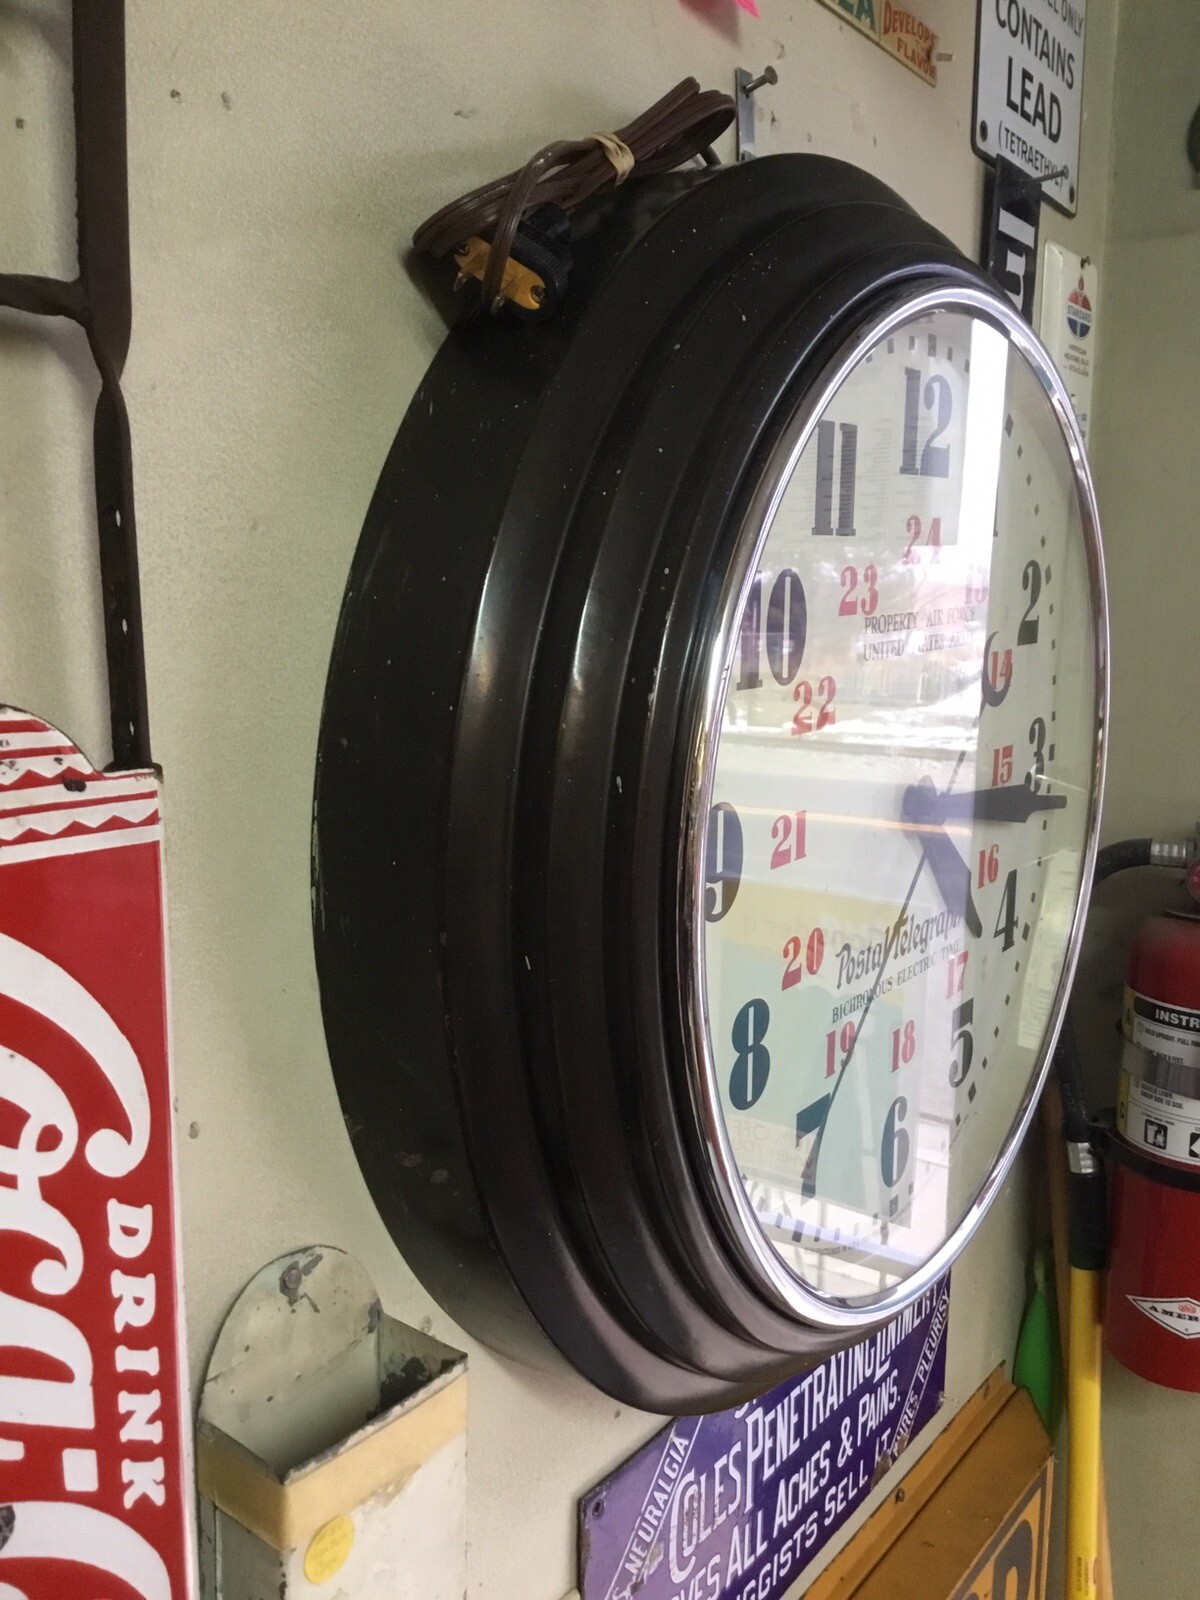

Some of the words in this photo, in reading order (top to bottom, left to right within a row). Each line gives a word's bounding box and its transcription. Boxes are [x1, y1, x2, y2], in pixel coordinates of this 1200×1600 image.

[996, 0, 1075, 90] CONTAINS
[1061, 0, 1084, 38] ONLY
[1006, 55, 1062, 144] LEAD
[1067, 304, 1092, 324] STANDARD
[900, 366, 952, 479] 12
[811, 419, 858, 537] 11
[902, 514, 942, 565] 24
[838, 563, 879, 617] 23
[864, 612, 919, 634] PROPERTY
[926, 608, 944, 628] AIR
[1016, 559, 1043, 647] 2
[736, 568, 808, 692] 10
[863, 638, 905, 662] UNITED
[990, 648, 1013, 690] 14
[790, 675, 837, 737] 22
[991, 744, 1014, 788] 15
[1024, 716, 1046, 796] 3
[705, 801, 744, 923] 9
[770, 809, 807, 871] 21
[977, 843, 1000, 890] 16
[993, 869, 1019, 953] 4
[781, 927, 825, 992] 20
[835, 927, 890, 991] Postal
[896, 952, 938, 987] ELECTRIC
[945, 950, 970, 1000] 17
[824, 1021, 856, 1080] 19
[890, 1019, 916, 1073] 18
[948, 997, 975, 1088] 5
[1155, 1008, 1200, 1030] INSTR
[729, 998, 771, 1110] 8
[795, 1092, 832, 1203] 7
[881, 1096, 910, 1188] 6
[106, 1198, 166, 1510] DRINK
[917, 1286, 950, 1385] PLEURISY
[744, 1339, 875, 1514] PENETRATING
[624, 1435, 690, 1577] NEURALGIA
[726, 1509, 768, 1588] ALL
[773, 1440, 831, 1539] ACHES
[837, 1416, 854, 1468] &
[824, 1460, 869, 1526] SELL
